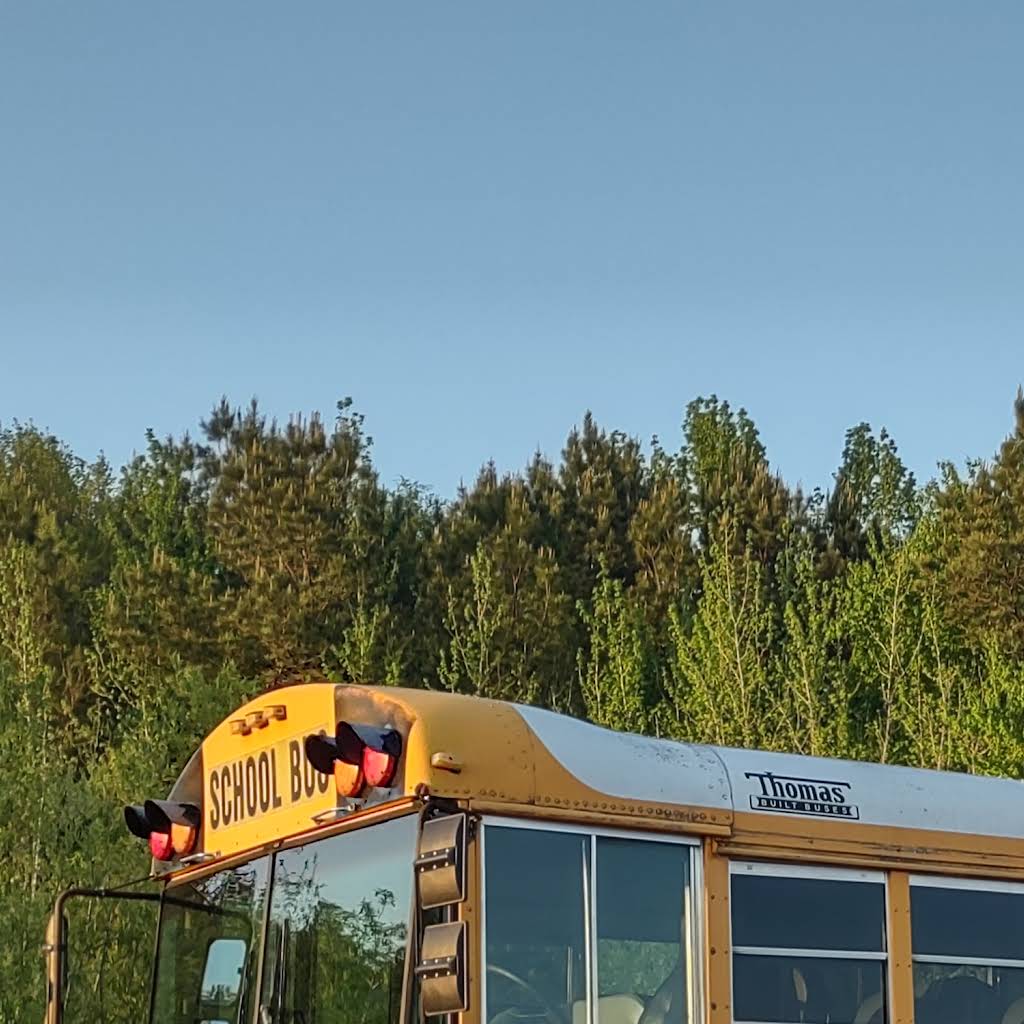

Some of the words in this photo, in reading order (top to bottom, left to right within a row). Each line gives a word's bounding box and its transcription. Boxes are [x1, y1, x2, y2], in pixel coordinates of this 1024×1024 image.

[210, 748, 282, 830] SCHOOL
[744, 771, 851, 803] Thomas
[760, 798, 797, 811] BUILT
[805, 803, 849, 815] BUSES
